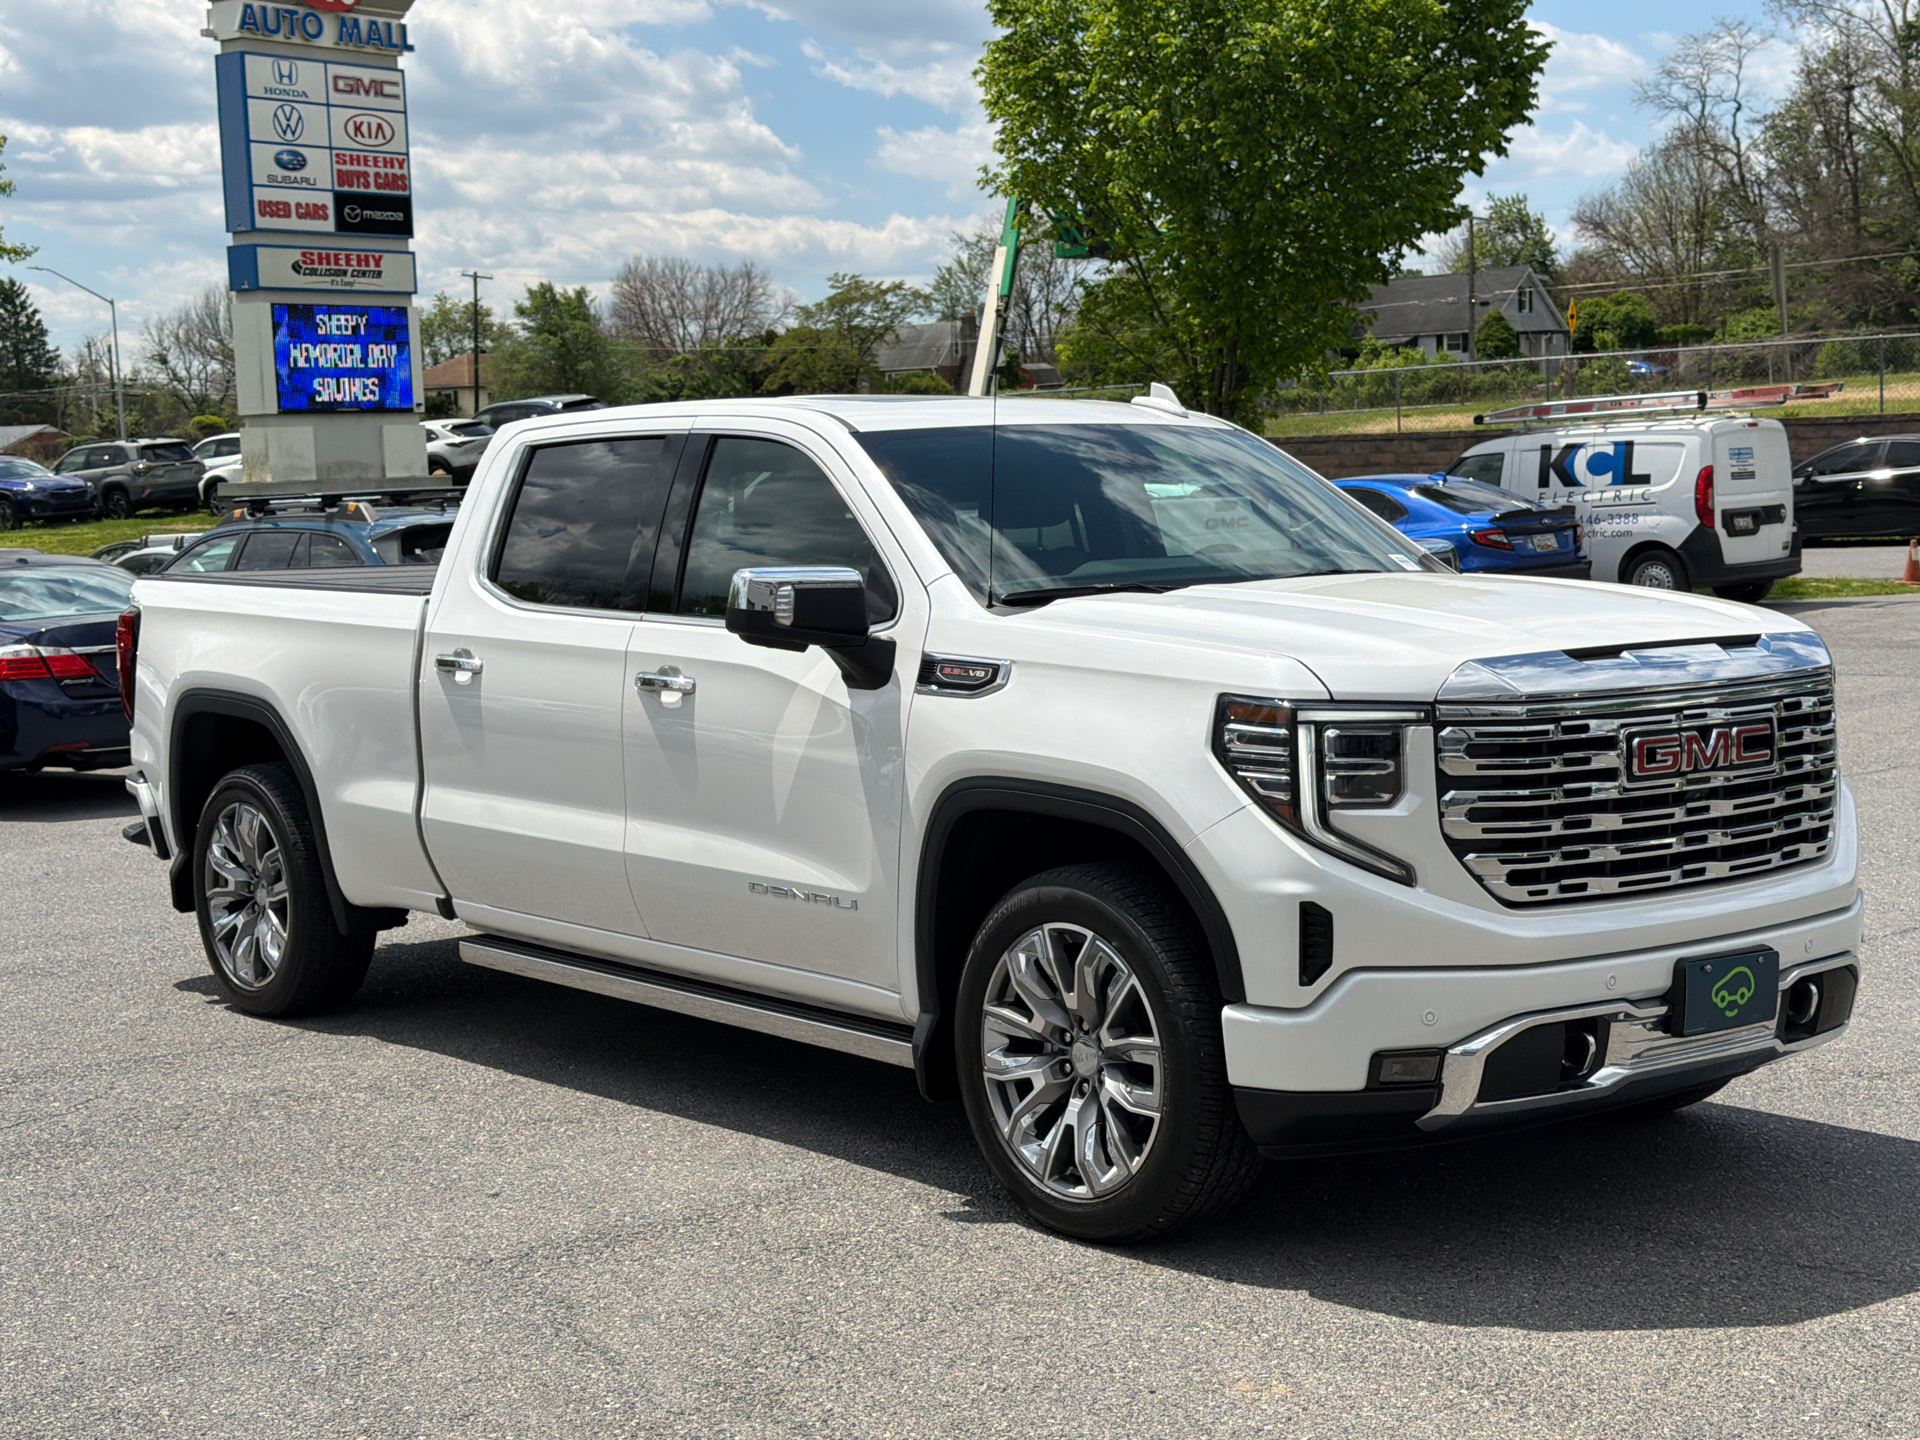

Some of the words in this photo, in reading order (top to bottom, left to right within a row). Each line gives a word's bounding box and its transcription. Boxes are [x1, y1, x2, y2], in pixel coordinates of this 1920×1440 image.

[239, 3, 324, 41] AUTO
[338, 16, 415, 52] MALL
[264, 86, 309, 99] HONDA
[333, 75, 401, 100] GMC
[353, 120, 387, 141] KIA
[334, 153, 406, 170] SHEEHY
[267, 174, 316, 186] SUBARU
[336, 169, 370, 190] BUYS
[374, 171, 408, 192] CARS
[257, 199, 292, 219] USED
[295, 202, 329, 221] CARS
[362, 210, 404, 221] mazda
[301, 251, 383, 268] SHEEHY
[302, 267, 349, 277] COLLISION
[350, 269, 383, 279] CENTER
[367, 343, 397, 368] DAY
[1538, 440, 1651, 488] KCL
[1538, 488, 1651, 504] ELECTRIC
[1205, 516, 1249, 530] GMC
[1583, 528, 1633, 539] ctric.com
[1632, 724, 1771, 776] GMC
[748, 881, 858, 911] DENALI
